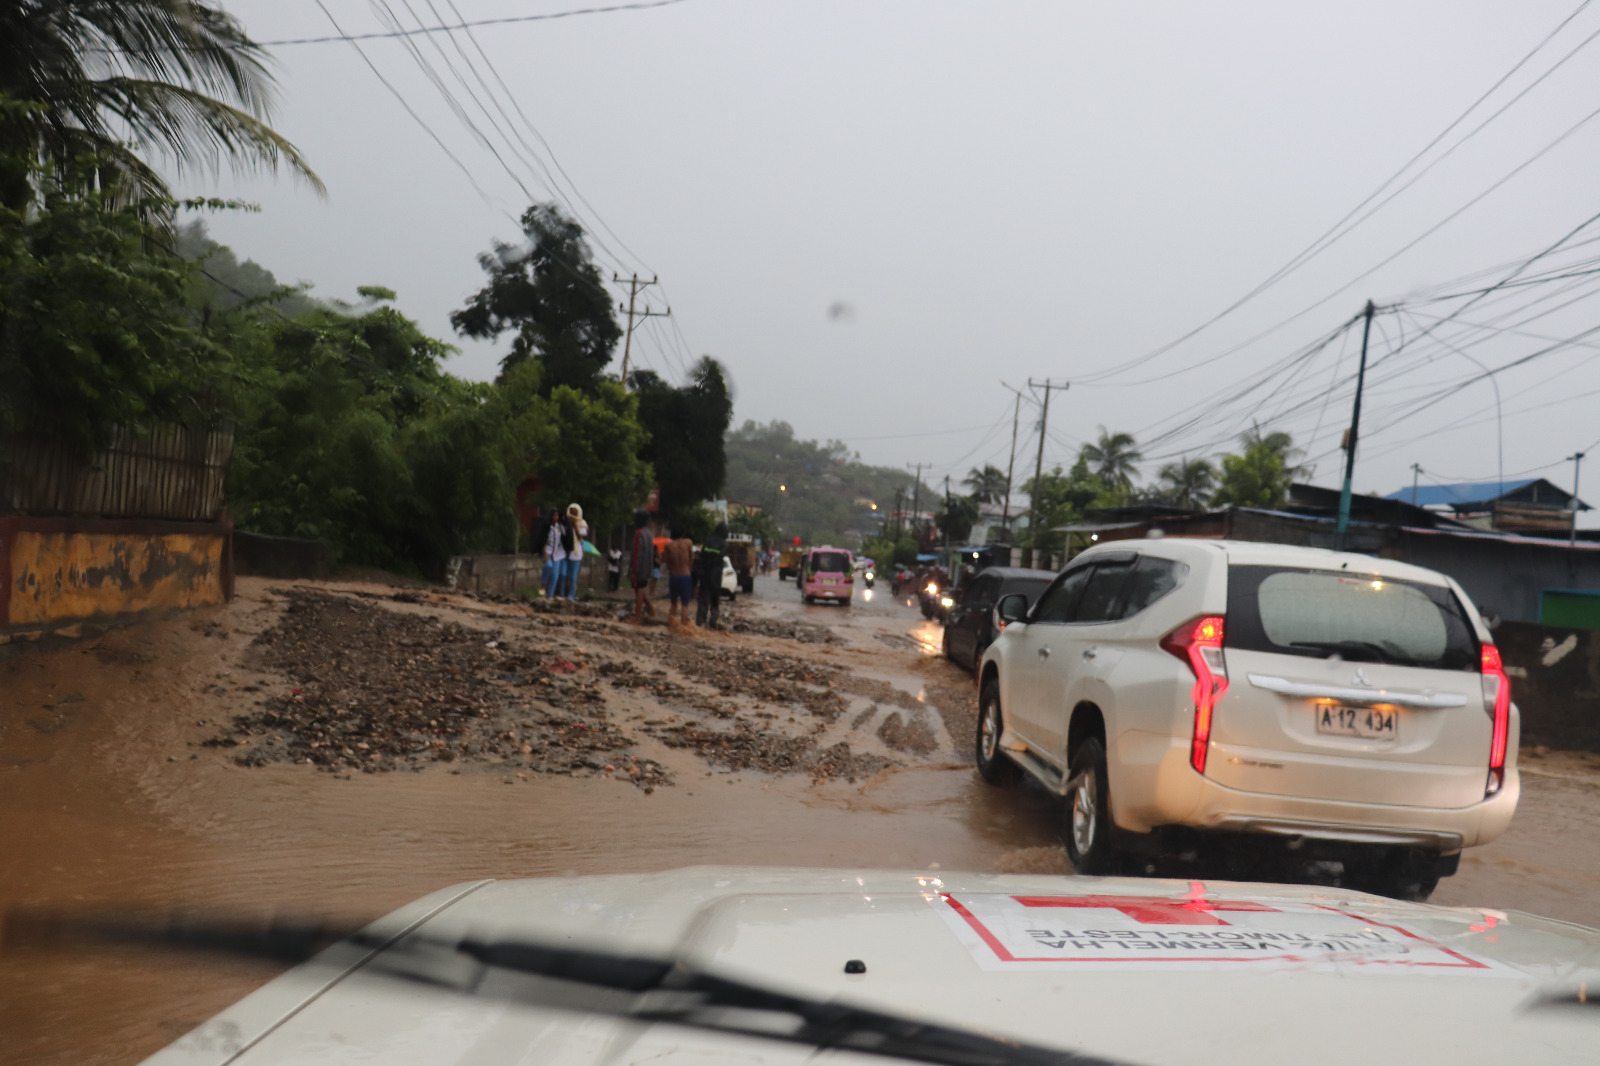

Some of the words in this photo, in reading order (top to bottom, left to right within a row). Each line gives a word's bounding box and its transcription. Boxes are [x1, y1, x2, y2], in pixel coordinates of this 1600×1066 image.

[1321, 707, 1332, 727] A
[1337, 708, 1355, 730] 12
[1364, 710, 1393, 732] 434
[1025, 930, 1312, 941] TIMOR-LESTE
[1036, 940, 1282, 950] VERMELHA
